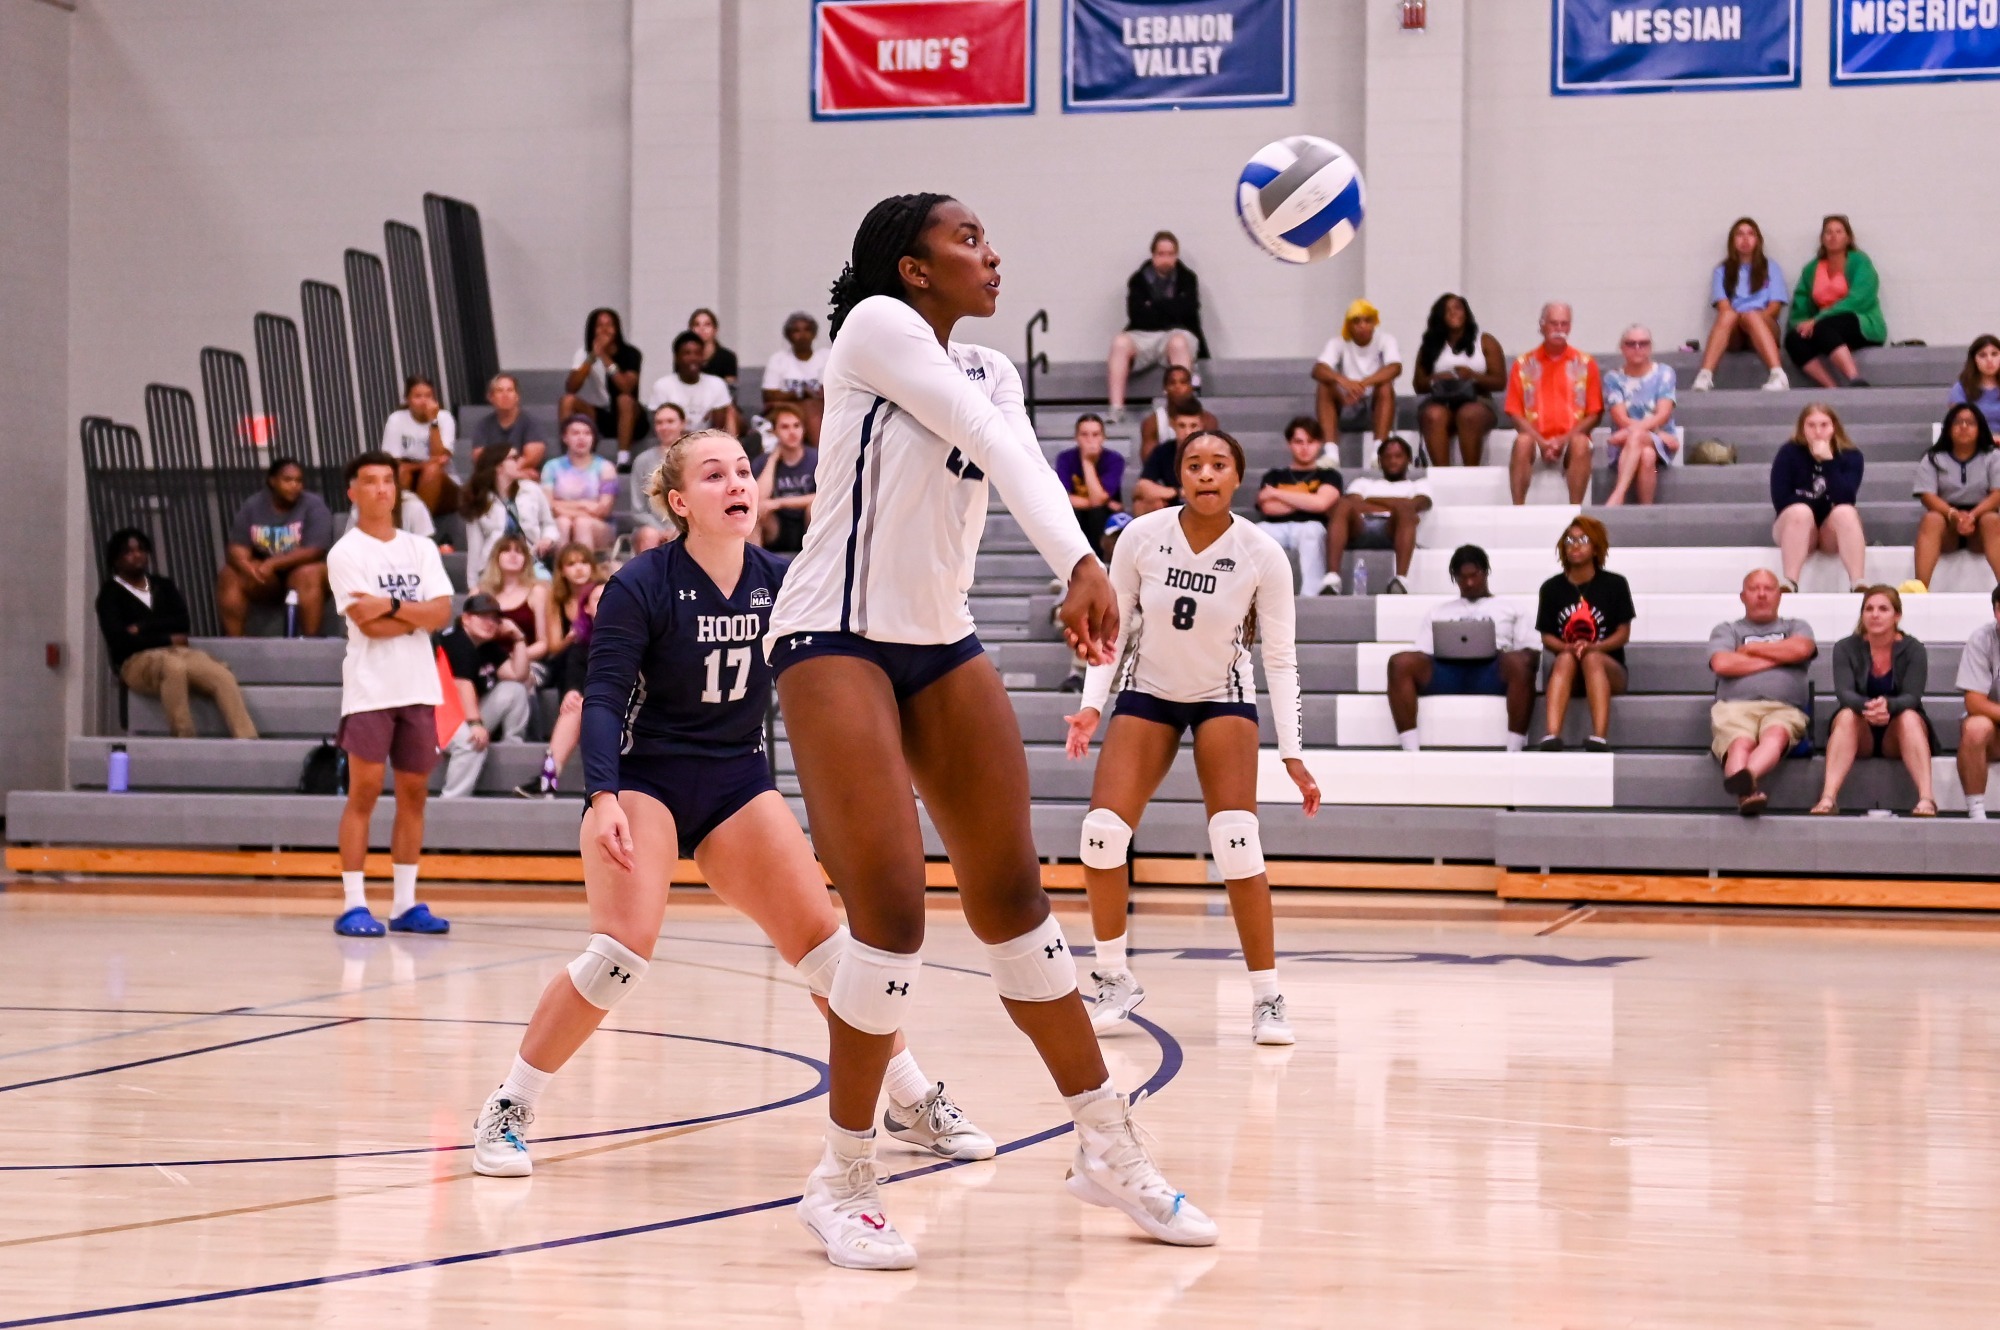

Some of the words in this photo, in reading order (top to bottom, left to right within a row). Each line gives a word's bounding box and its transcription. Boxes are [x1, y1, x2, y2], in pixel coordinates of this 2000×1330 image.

[1123, 14, 1233, 45] LEBANON
[1611, 6, 1741, 44] MESSIAH
[877, 37, 969, 72] KING'S
[1132, 46, 1224, 77] VALLEY
[1165, 568, 1217, 594] HOOD
[752, 596, 771, 606] MAC
[1172, 596, 1197, 630] 8
[697, 613, 760, 642] HOOD
[700, 646, 752, 703] 17
